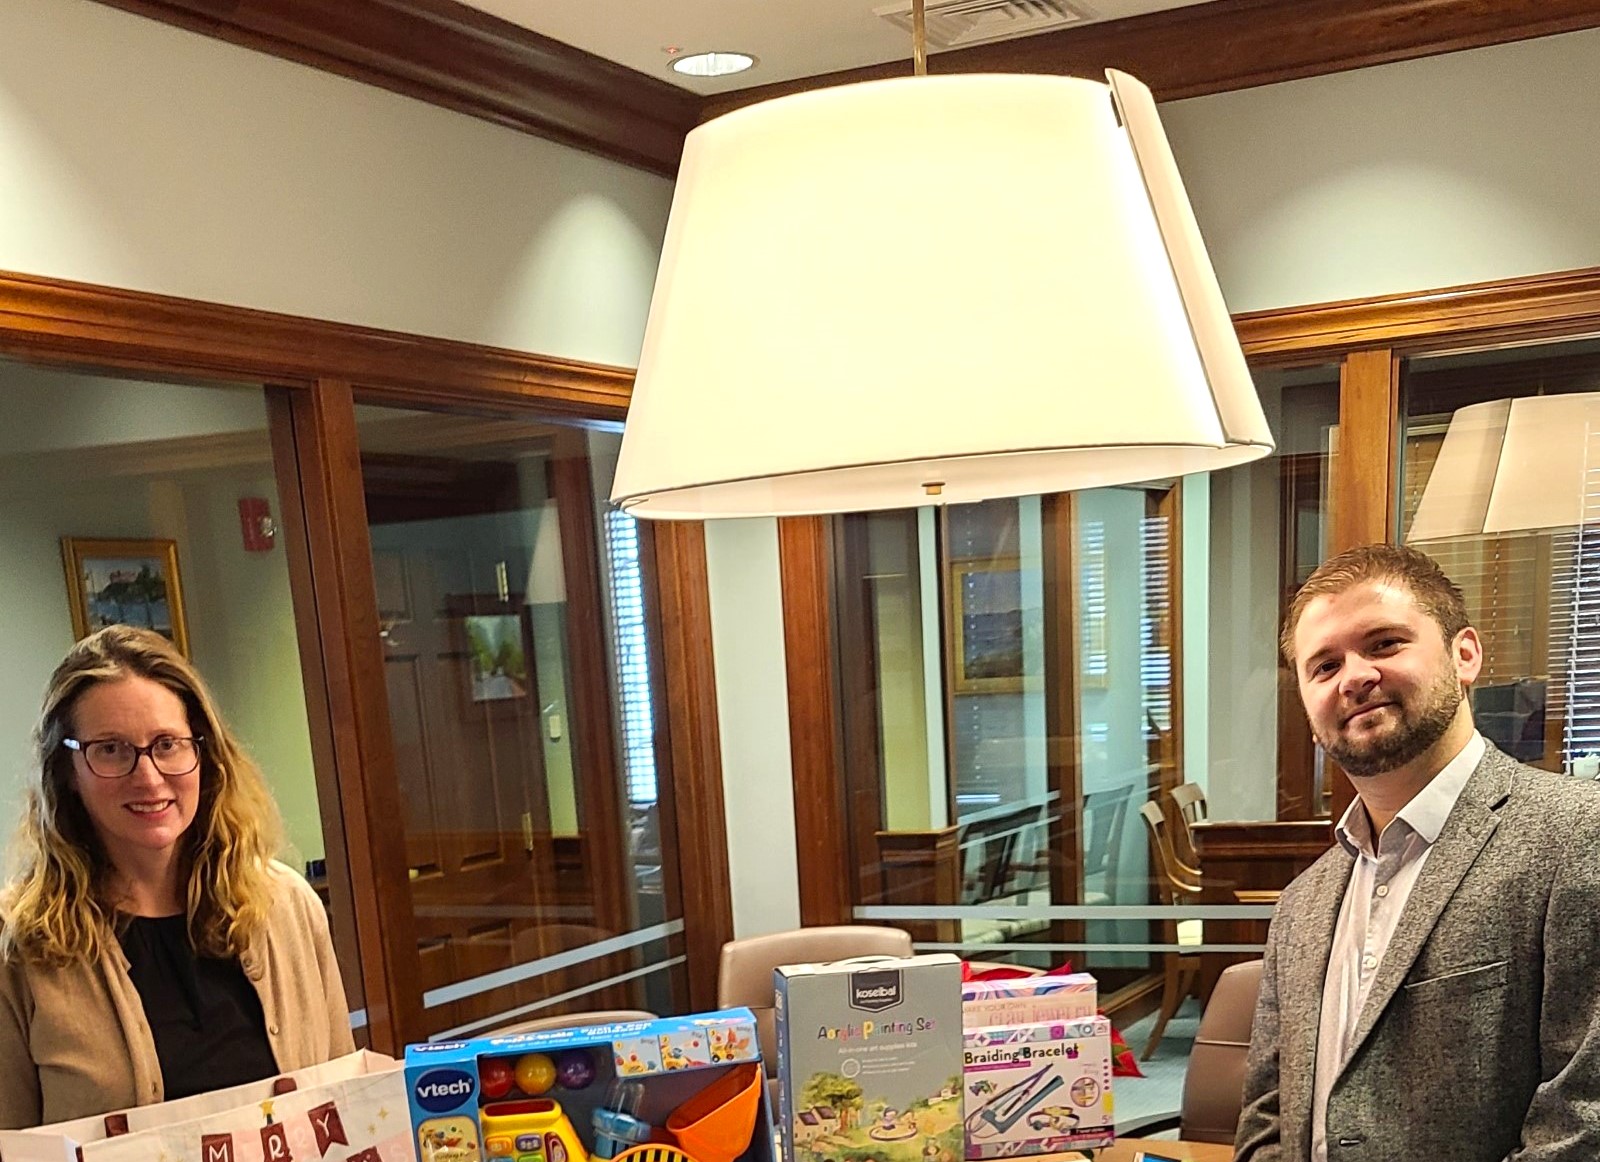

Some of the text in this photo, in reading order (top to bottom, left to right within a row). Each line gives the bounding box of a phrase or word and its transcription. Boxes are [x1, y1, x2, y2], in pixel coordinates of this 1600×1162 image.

[964, 1043, 1078, 1064] Braiding Bracelet
[417, 1079, 471, 1098] vtech
